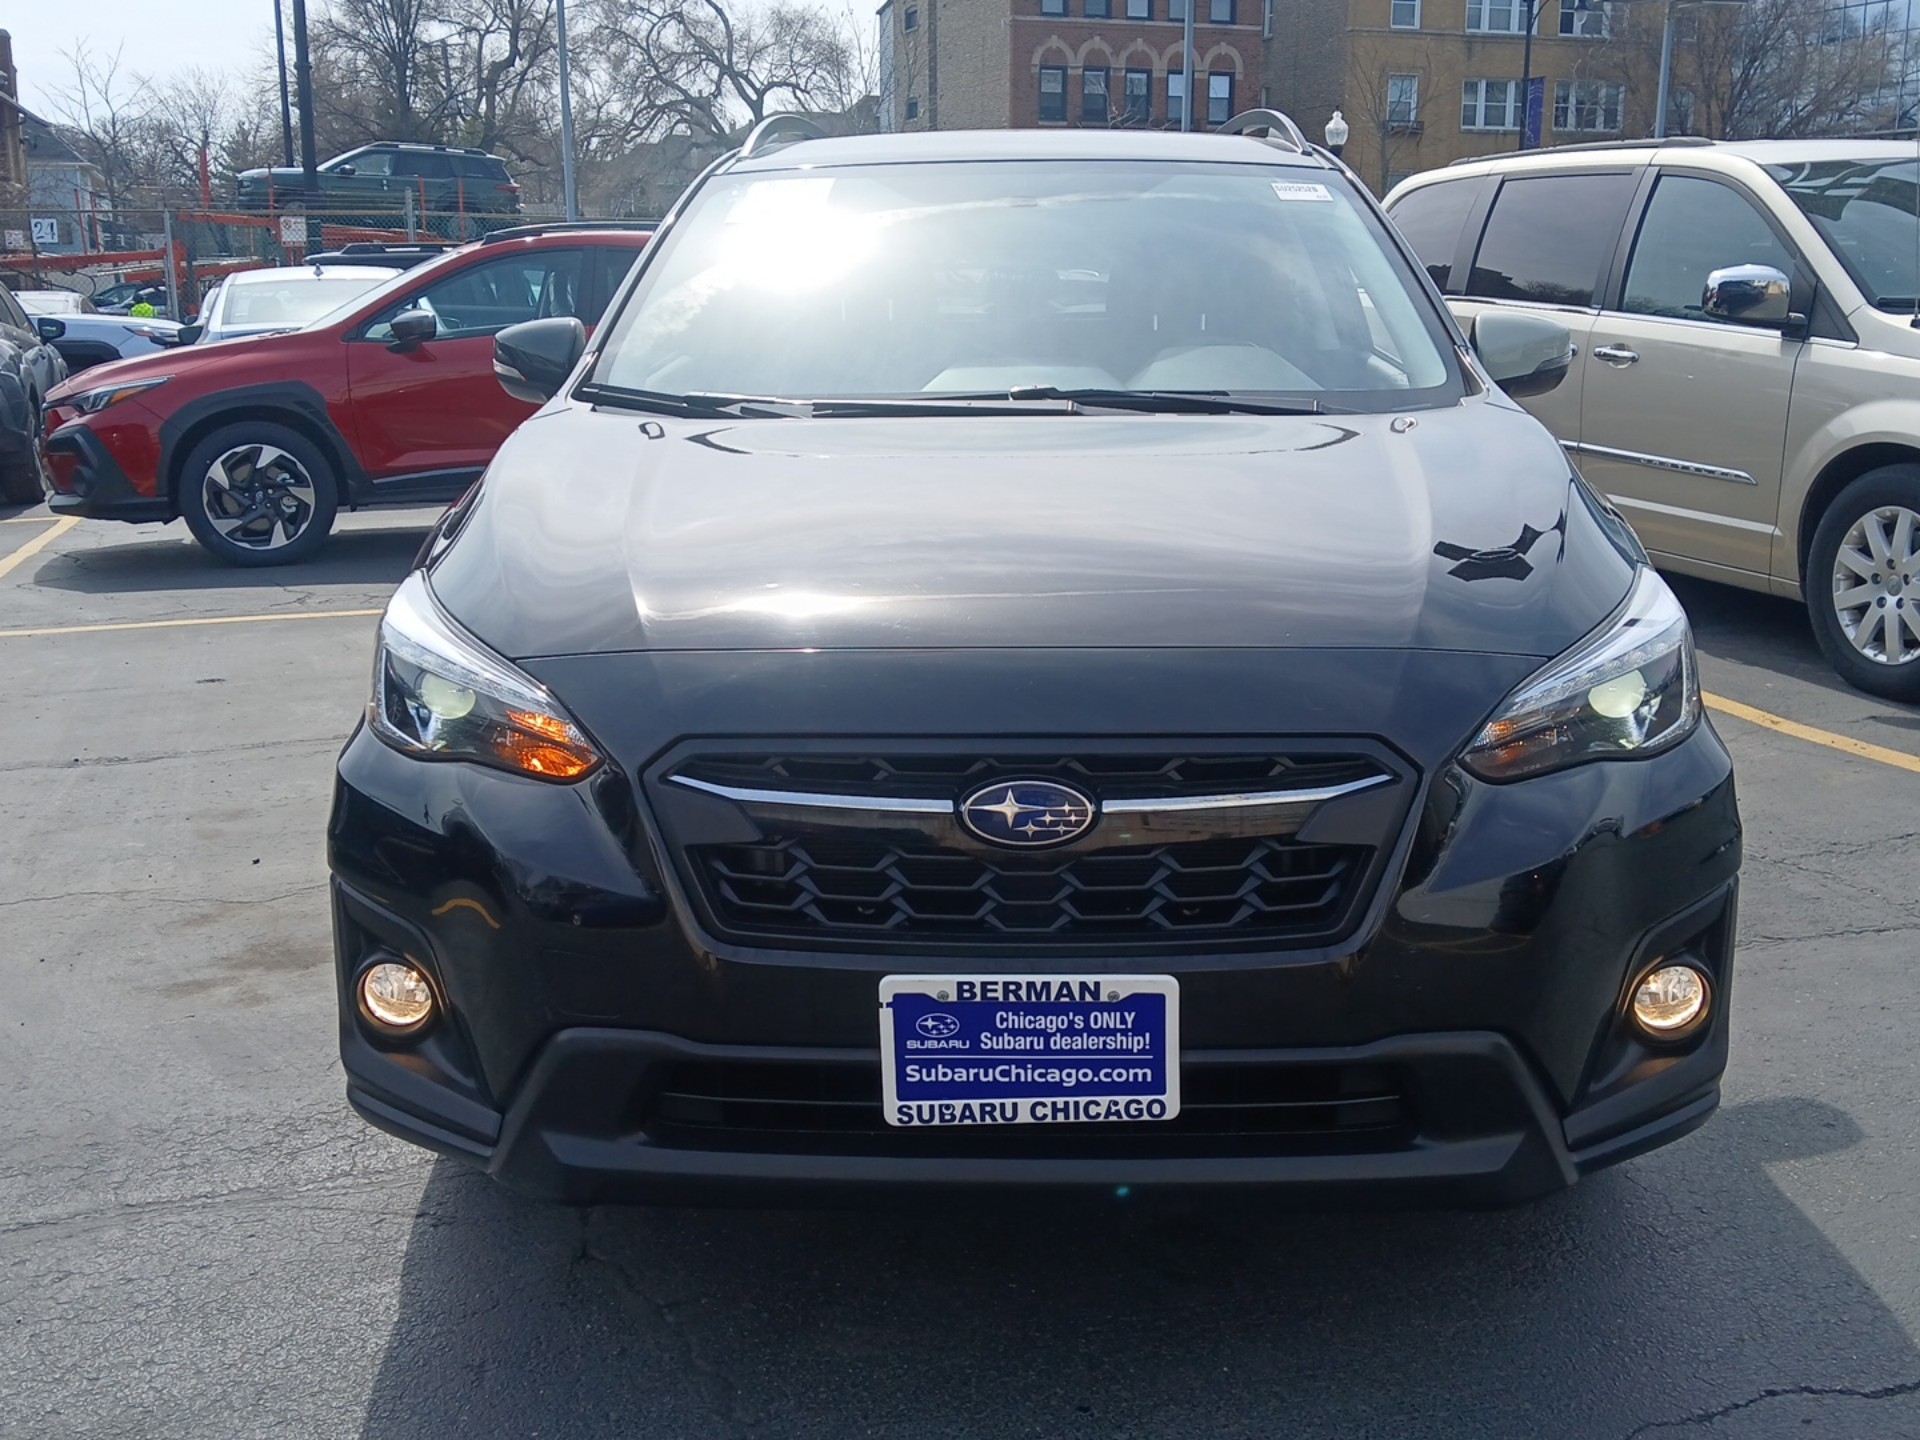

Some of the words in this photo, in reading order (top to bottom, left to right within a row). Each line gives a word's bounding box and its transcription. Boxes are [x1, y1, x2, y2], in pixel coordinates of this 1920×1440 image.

[34, 221, 56, 240] 24
[956, 981, 1101, 1001] BERMAN
[996, 1011, 1084, 1032] Chicago's
[1089, 1011, 1136, 1029] ONLY
[906, 1039, 970, 1049] SUBARU
[980, 1032, 1044, 1050] Subaru
[1050, 1032, 1150, 1053] dealership!
[906, 1064, 1152, 1087] SubaruChicago.com
[897, 1102, 1019, 1124] SUBARU
[1029, 1099, 1167, 1122] CHICAGO
